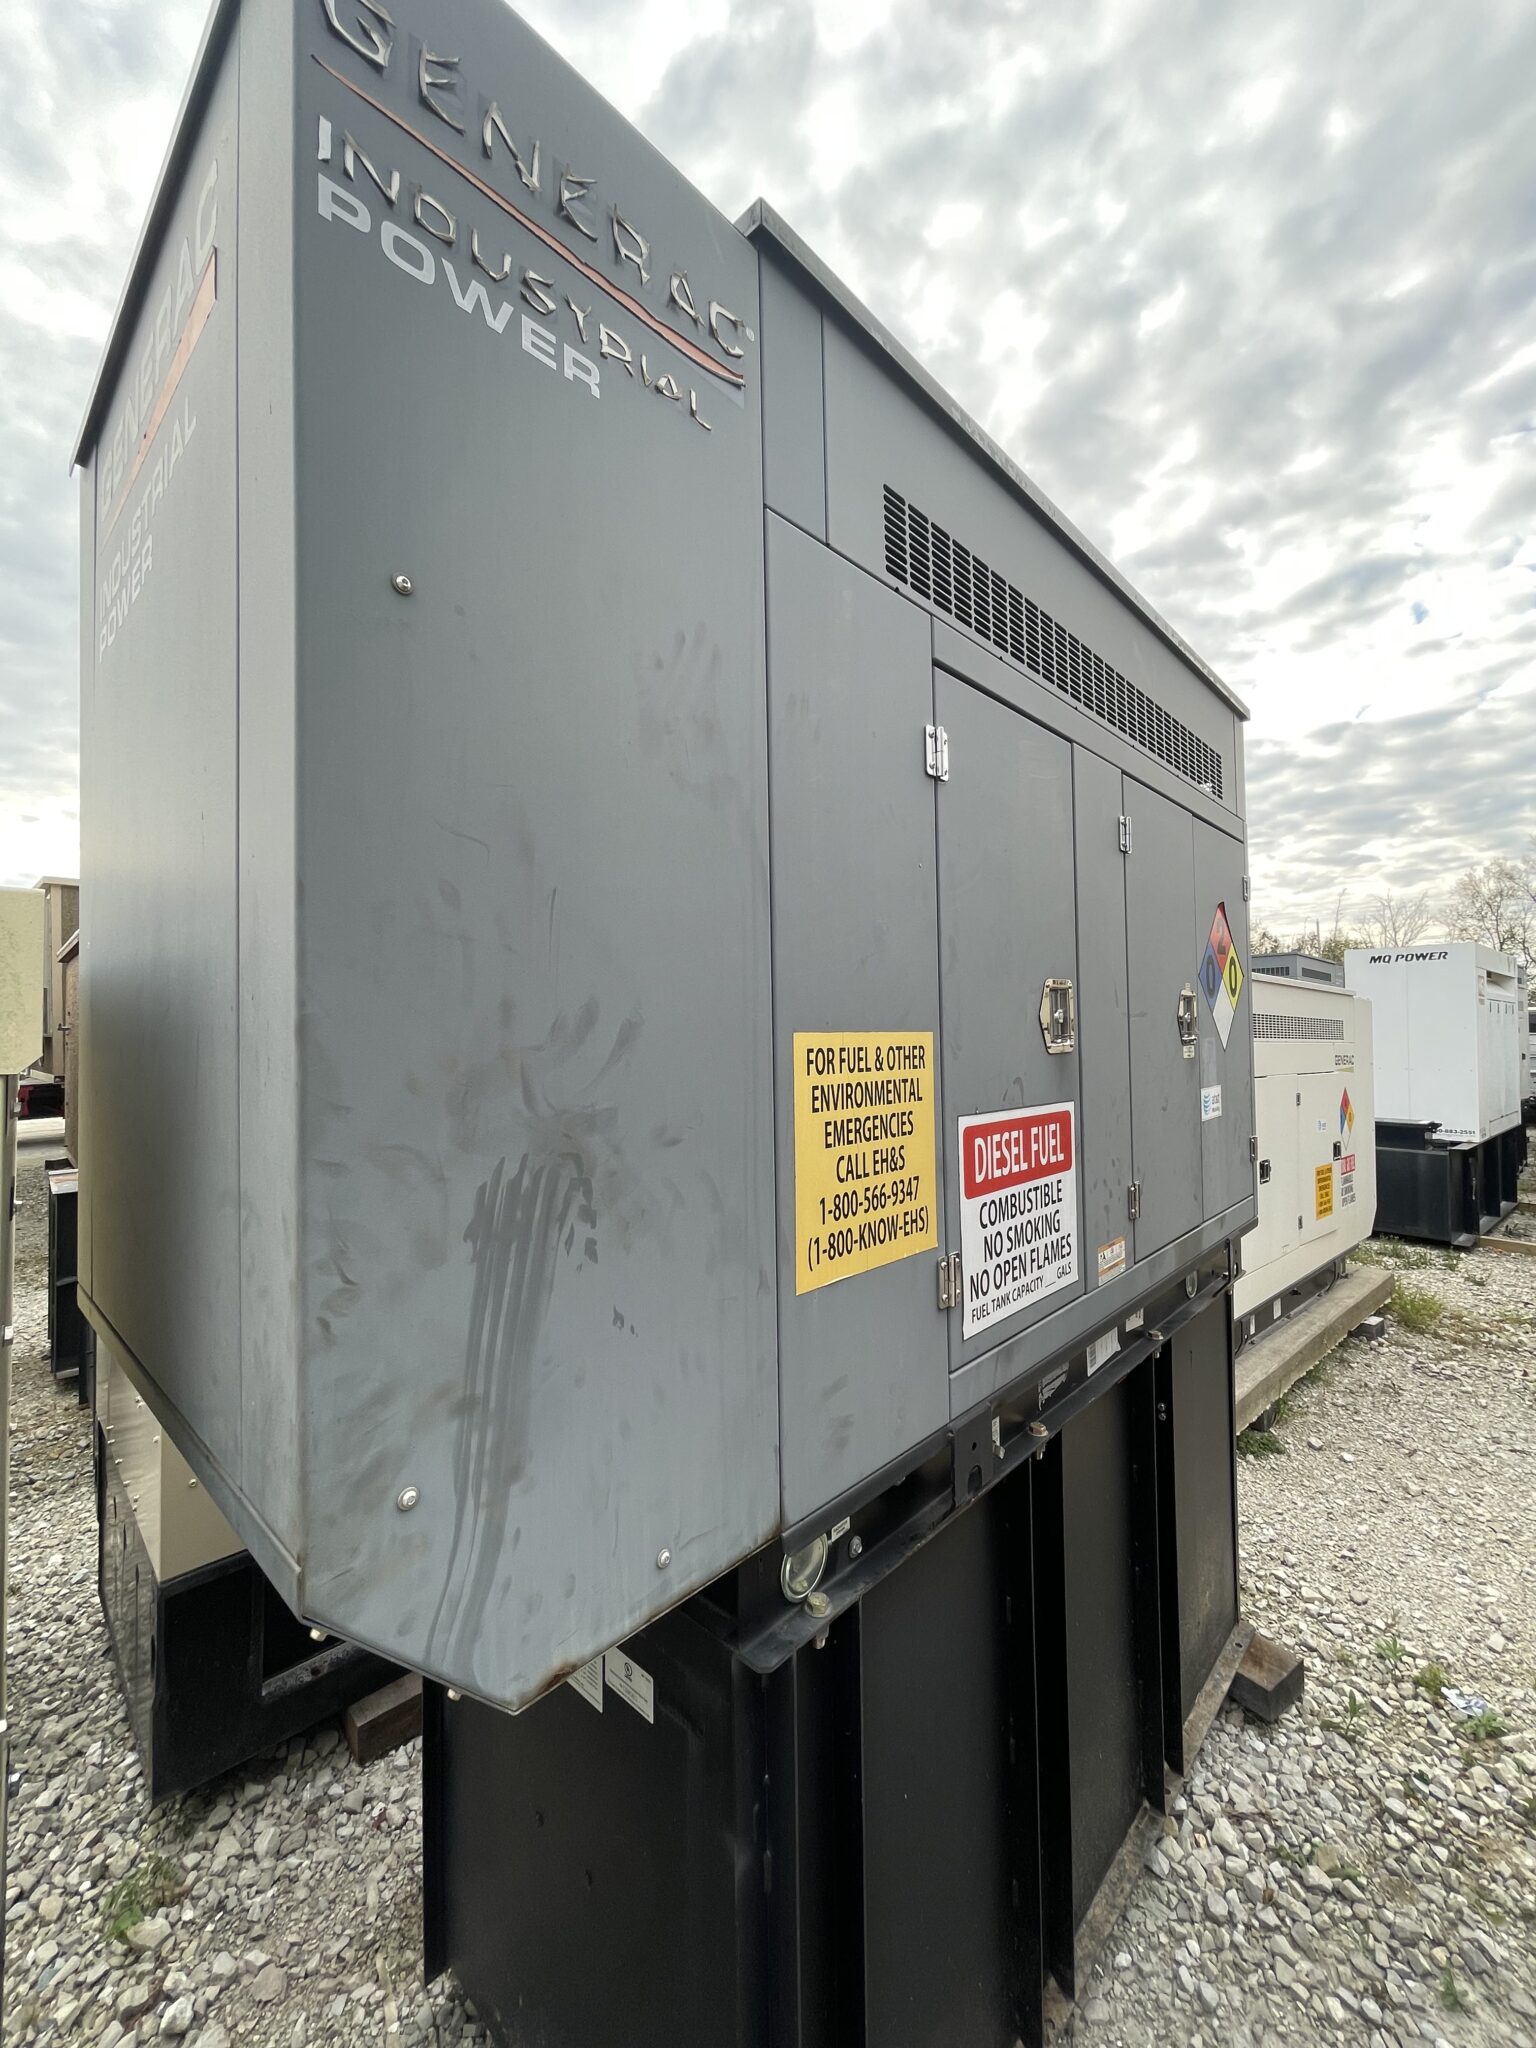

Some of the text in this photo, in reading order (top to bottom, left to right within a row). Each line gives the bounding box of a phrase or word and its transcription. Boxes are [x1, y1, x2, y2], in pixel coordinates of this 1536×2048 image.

[321, 0, 746, 359] GENERAC
[317, 114, 711, 431] INDUSTRIAL
[317, 172, 600, 399] POWER
[101, 158, 218, 522] GENERAC
[99, 533, 153, 665] POWER
[1205, 954, 1216, 999] 0
[1228, 955, 1238, 998] 0
[1369, 951, 1449, 964] MQ POWER
[806, 1045, 926, 1076] FOR FUEL & OTHER
[811, 1077, 923, 1114] ENVIRONMENTAL
[824, 1110, 914, 1149] EMERGENCIES
[974, 1122, 1064, 1184] DIESEL FUEL
[836, 1144, 906, 1184] CALL EH&S
[819, 1175, 920, 1225] 1-800-566-9347
[979, 1179, 1063, 1229] COMBUSTIBLE
[808, 1205, 929, 1271] (1-800-KNOW-EHS)
[983, 1209, 1061, 1263] NO SMOKING
[970, 1270, 990, 1302] NO
[993, 1256, 1028, 1293] OPEN
[1030, 1233, 1072, 1274] FLAMES
[971, 1262, 1072, 1324] FUEL TANK CAPACITY GALS
